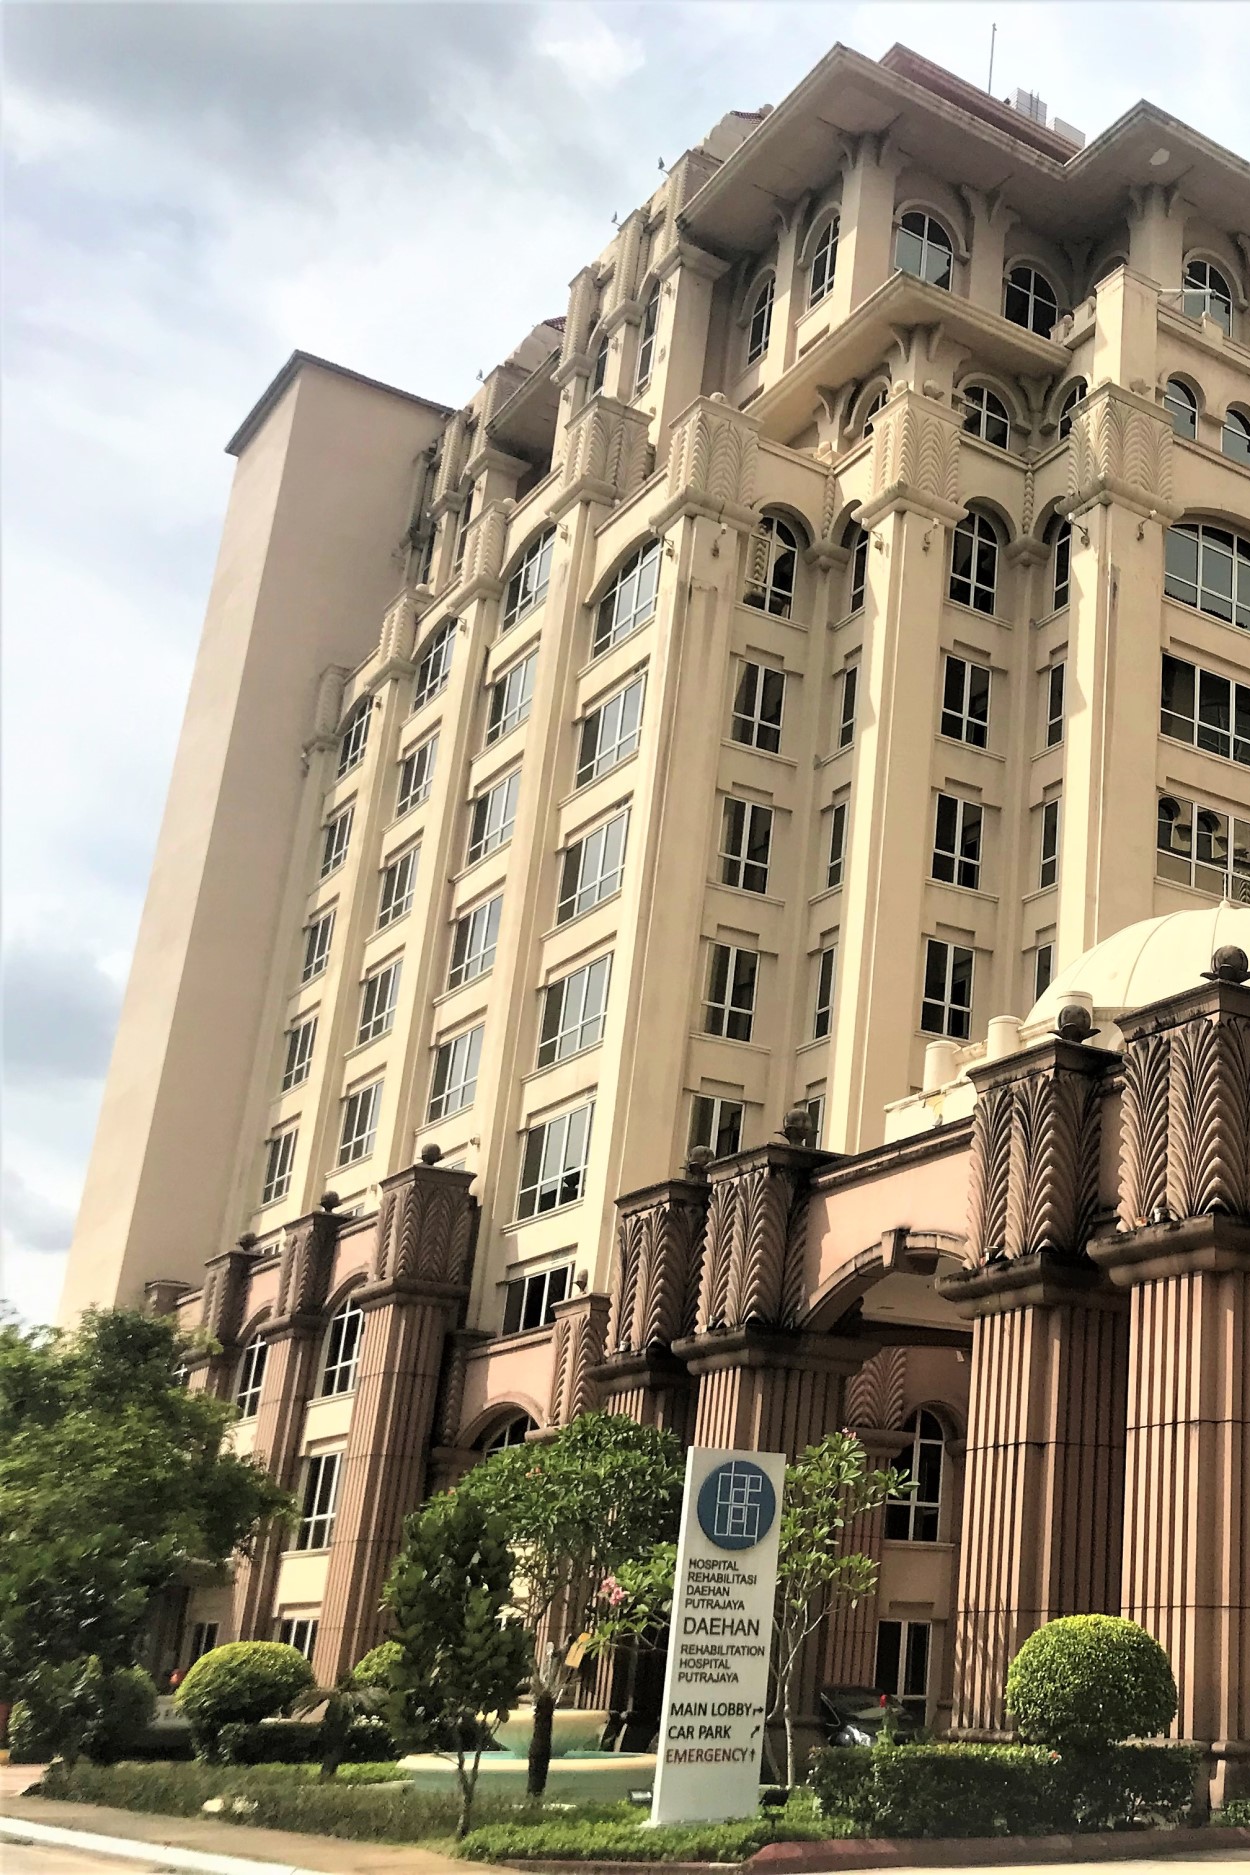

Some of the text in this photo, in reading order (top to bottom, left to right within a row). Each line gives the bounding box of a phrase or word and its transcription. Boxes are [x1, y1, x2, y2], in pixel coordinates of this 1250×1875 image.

[689, 1558, 739, 1571] HOSPITAL
[687, 1571, 757, 1585] REHABILITASI
[686, 1584, 730, 1597] DAEHAN
[685, 1598, 745, 1611] PUTRAJAYA
[683, 1616, 760, 1636] DAEHAN
[680, 1643, 765, 1657] REHABILITATION
[679, 1657, 731, 1670] HOSPITAL
[678, 1671, 739, 1684] PUTRAJAYA
[670, 1702, 752, 1717] MAIN LOBBY
[668, 1724, 732, 1740] CAR PARK
[665, 1747, 748, 1765] EMERGENCY
